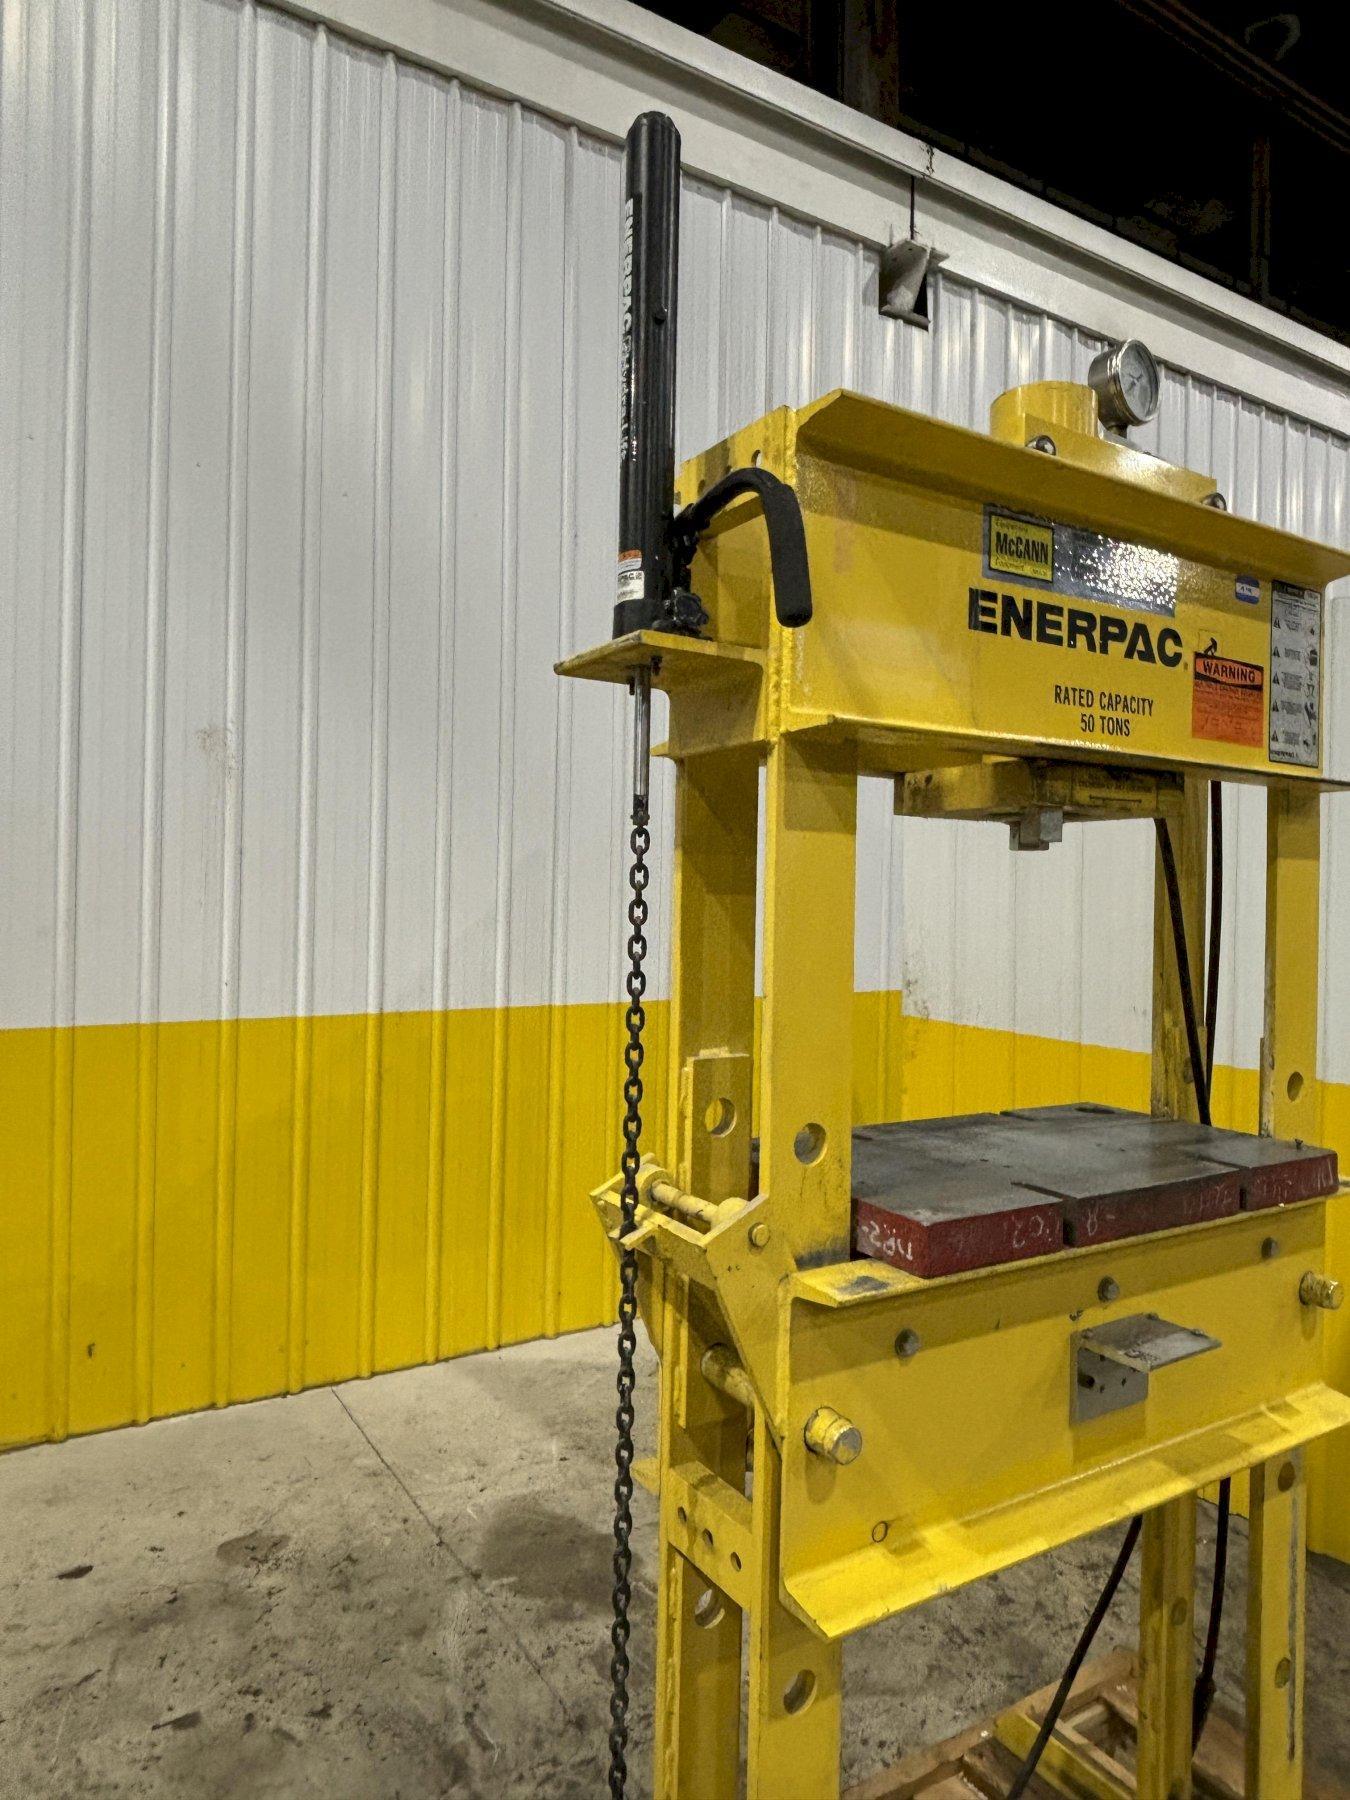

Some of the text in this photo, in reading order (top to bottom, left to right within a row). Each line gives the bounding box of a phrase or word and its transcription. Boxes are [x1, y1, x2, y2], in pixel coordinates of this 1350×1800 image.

[995, 531, 1049, 565] McCANN
[968, 587, 1184, 668] ENERPAC
[1202, 660, 1256, 683] WARNING
[1054, 684, 1154, 716] RATED CAPACITY
[1080, 713, 1131, 737] 50 TONS
